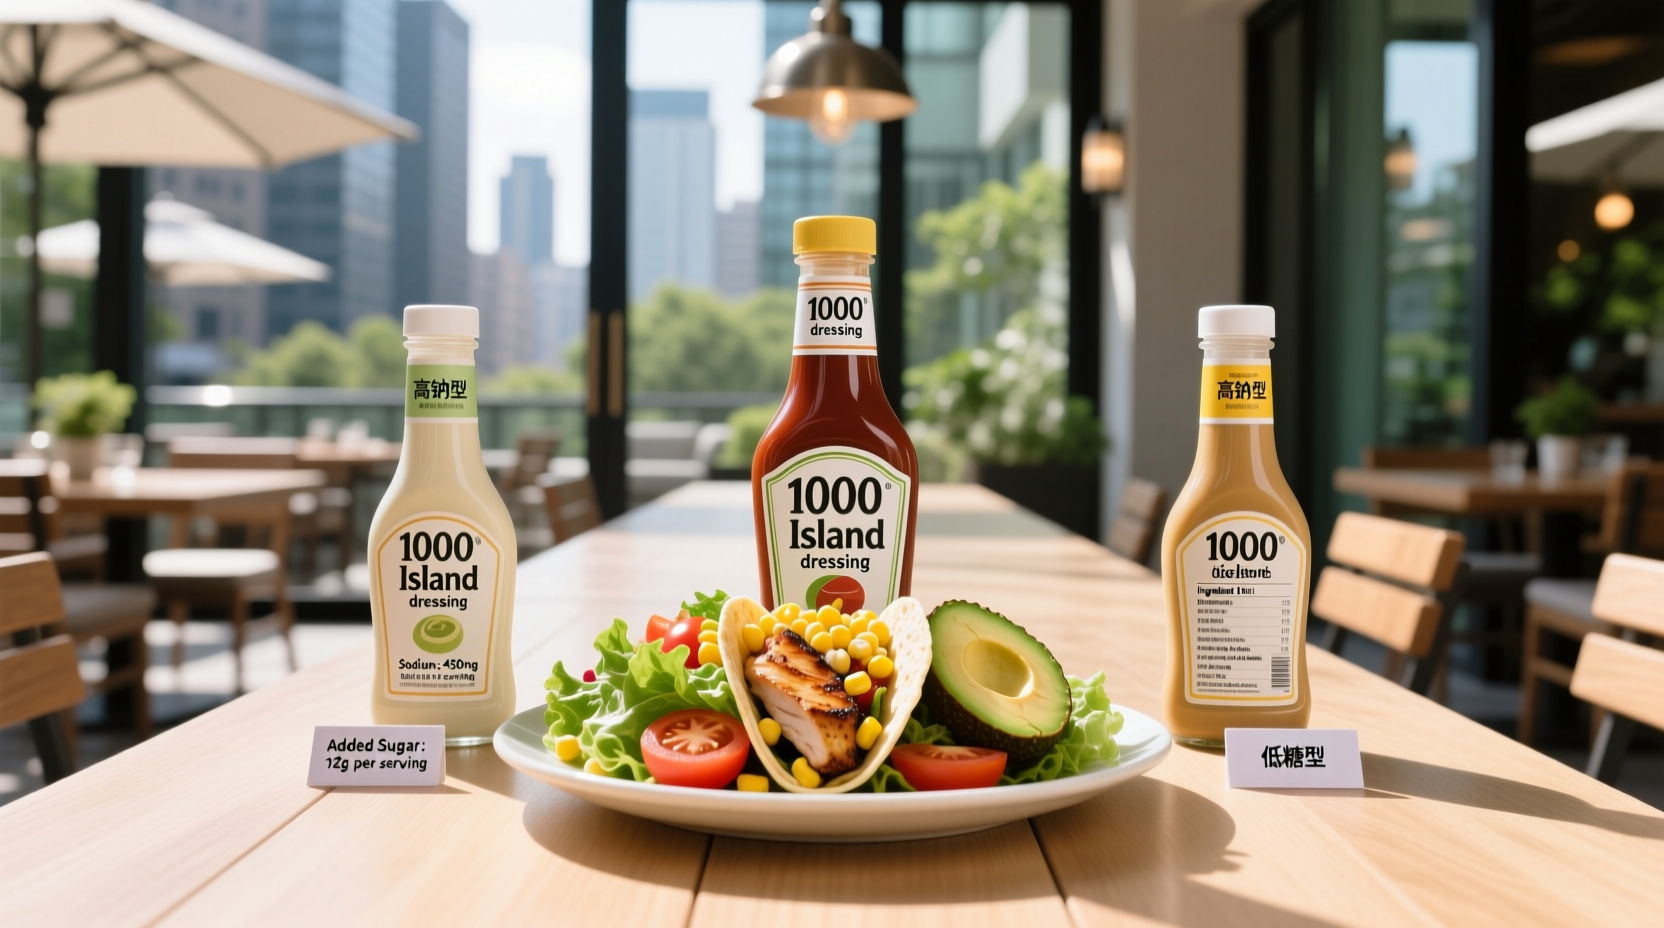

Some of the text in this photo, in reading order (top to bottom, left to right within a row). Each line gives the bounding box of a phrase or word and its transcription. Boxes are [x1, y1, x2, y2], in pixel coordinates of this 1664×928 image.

[808, 296, 863, 321] 1000
[810, 323, 863, 339] dressing
[413, 377, 467, 400] 高钠型
[787, 475, 882, 515] 1000
[399, 531, 474, 562] 1000
[789, 518, 885, 550] Island
[1206, 531, 1279, 562] 1000
[800, 553, 871, 573] dressing
[399, 564, 479, 591] Island
[409, 594, 468, 611] dressing
[327, 737, 426, 756] Added Sugar:
[1261, 744, 1327, 769] 低糖型
[325, 756, 428, 773] 12g per serving
